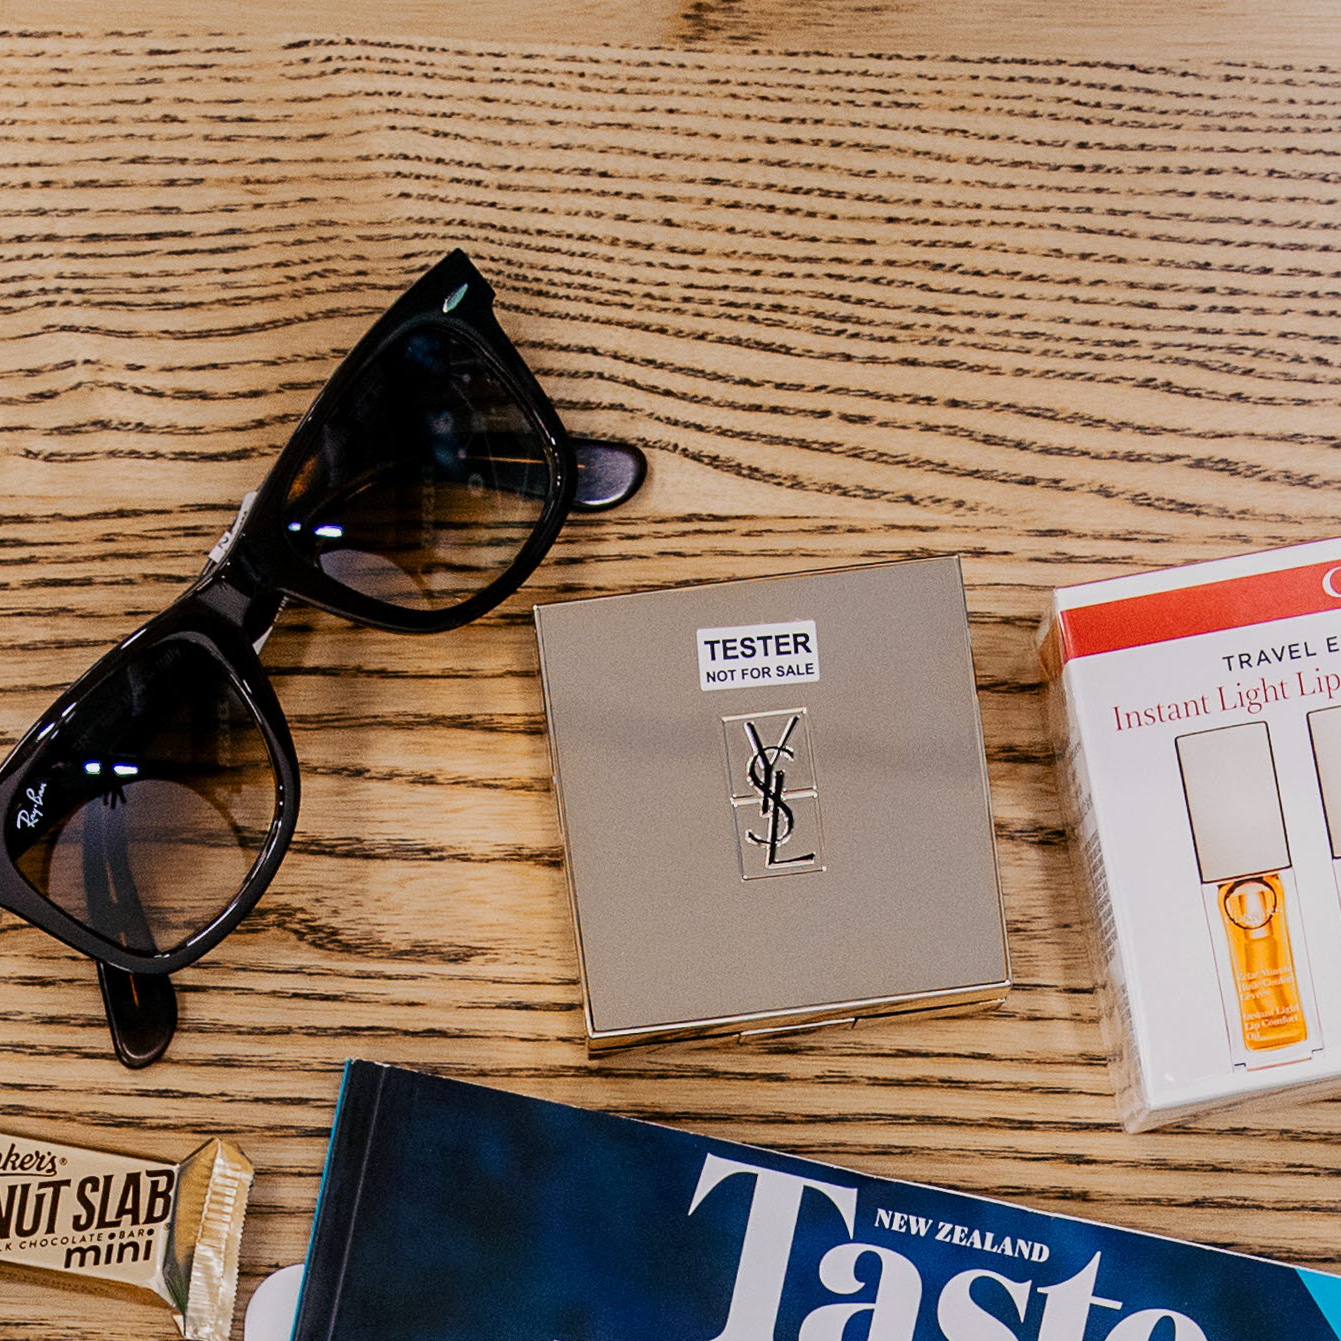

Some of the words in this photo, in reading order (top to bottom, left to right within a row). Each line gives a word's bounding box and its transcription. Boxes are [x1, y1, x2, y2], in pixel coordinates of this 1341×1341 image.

[704, 631, 813, 662] TESTER
[1221, 639, 1317, 673] TRAVEL
[706, 668, 736, 684] NOT
[741, 665, 772, 681] FOR
[776, 662, 814, 678] SALE
[1113, 692, 1212, 733] Instant
[1219, 678, 1289, 714] Light
[1297, 670, 1341, 702] Lip
[72, 1168, 176, 1233] SLAB
[18, 1233, 105, 1250] CHOCOLATE
[874, 1208, 934, 1239] NEW
[935, 1222, 1051, 1264] ZEALAND
[64, 1239, 154, 1269] mini
